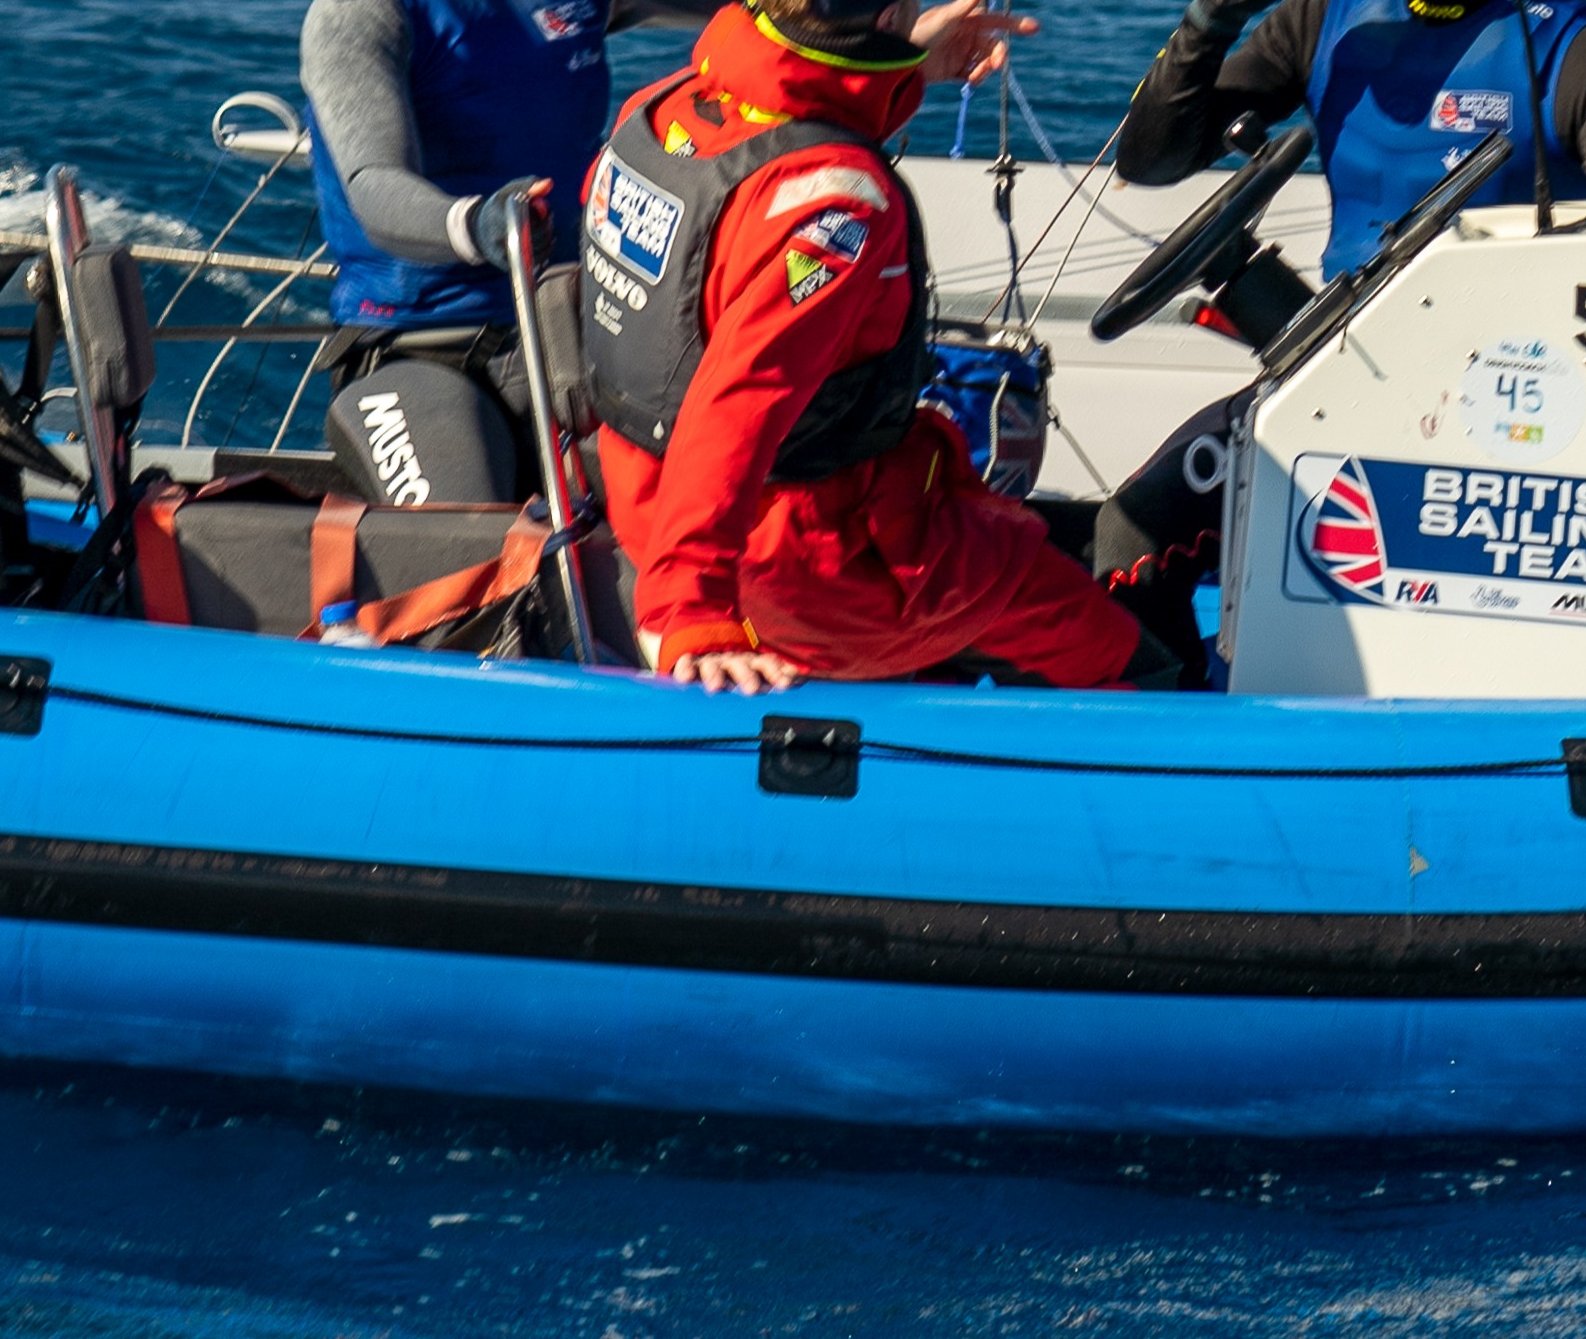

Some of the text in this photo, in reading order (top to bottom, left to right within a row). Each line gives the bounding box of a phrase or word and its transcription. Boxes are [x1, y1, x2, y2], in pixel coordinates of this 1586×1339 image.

[586, 243, 649, 311] VOLVO
[1495, 374, 1544, 414] 45
[357, 392, 431, 509] MUSTO
[1395, 579, 1440, 605] RYA
